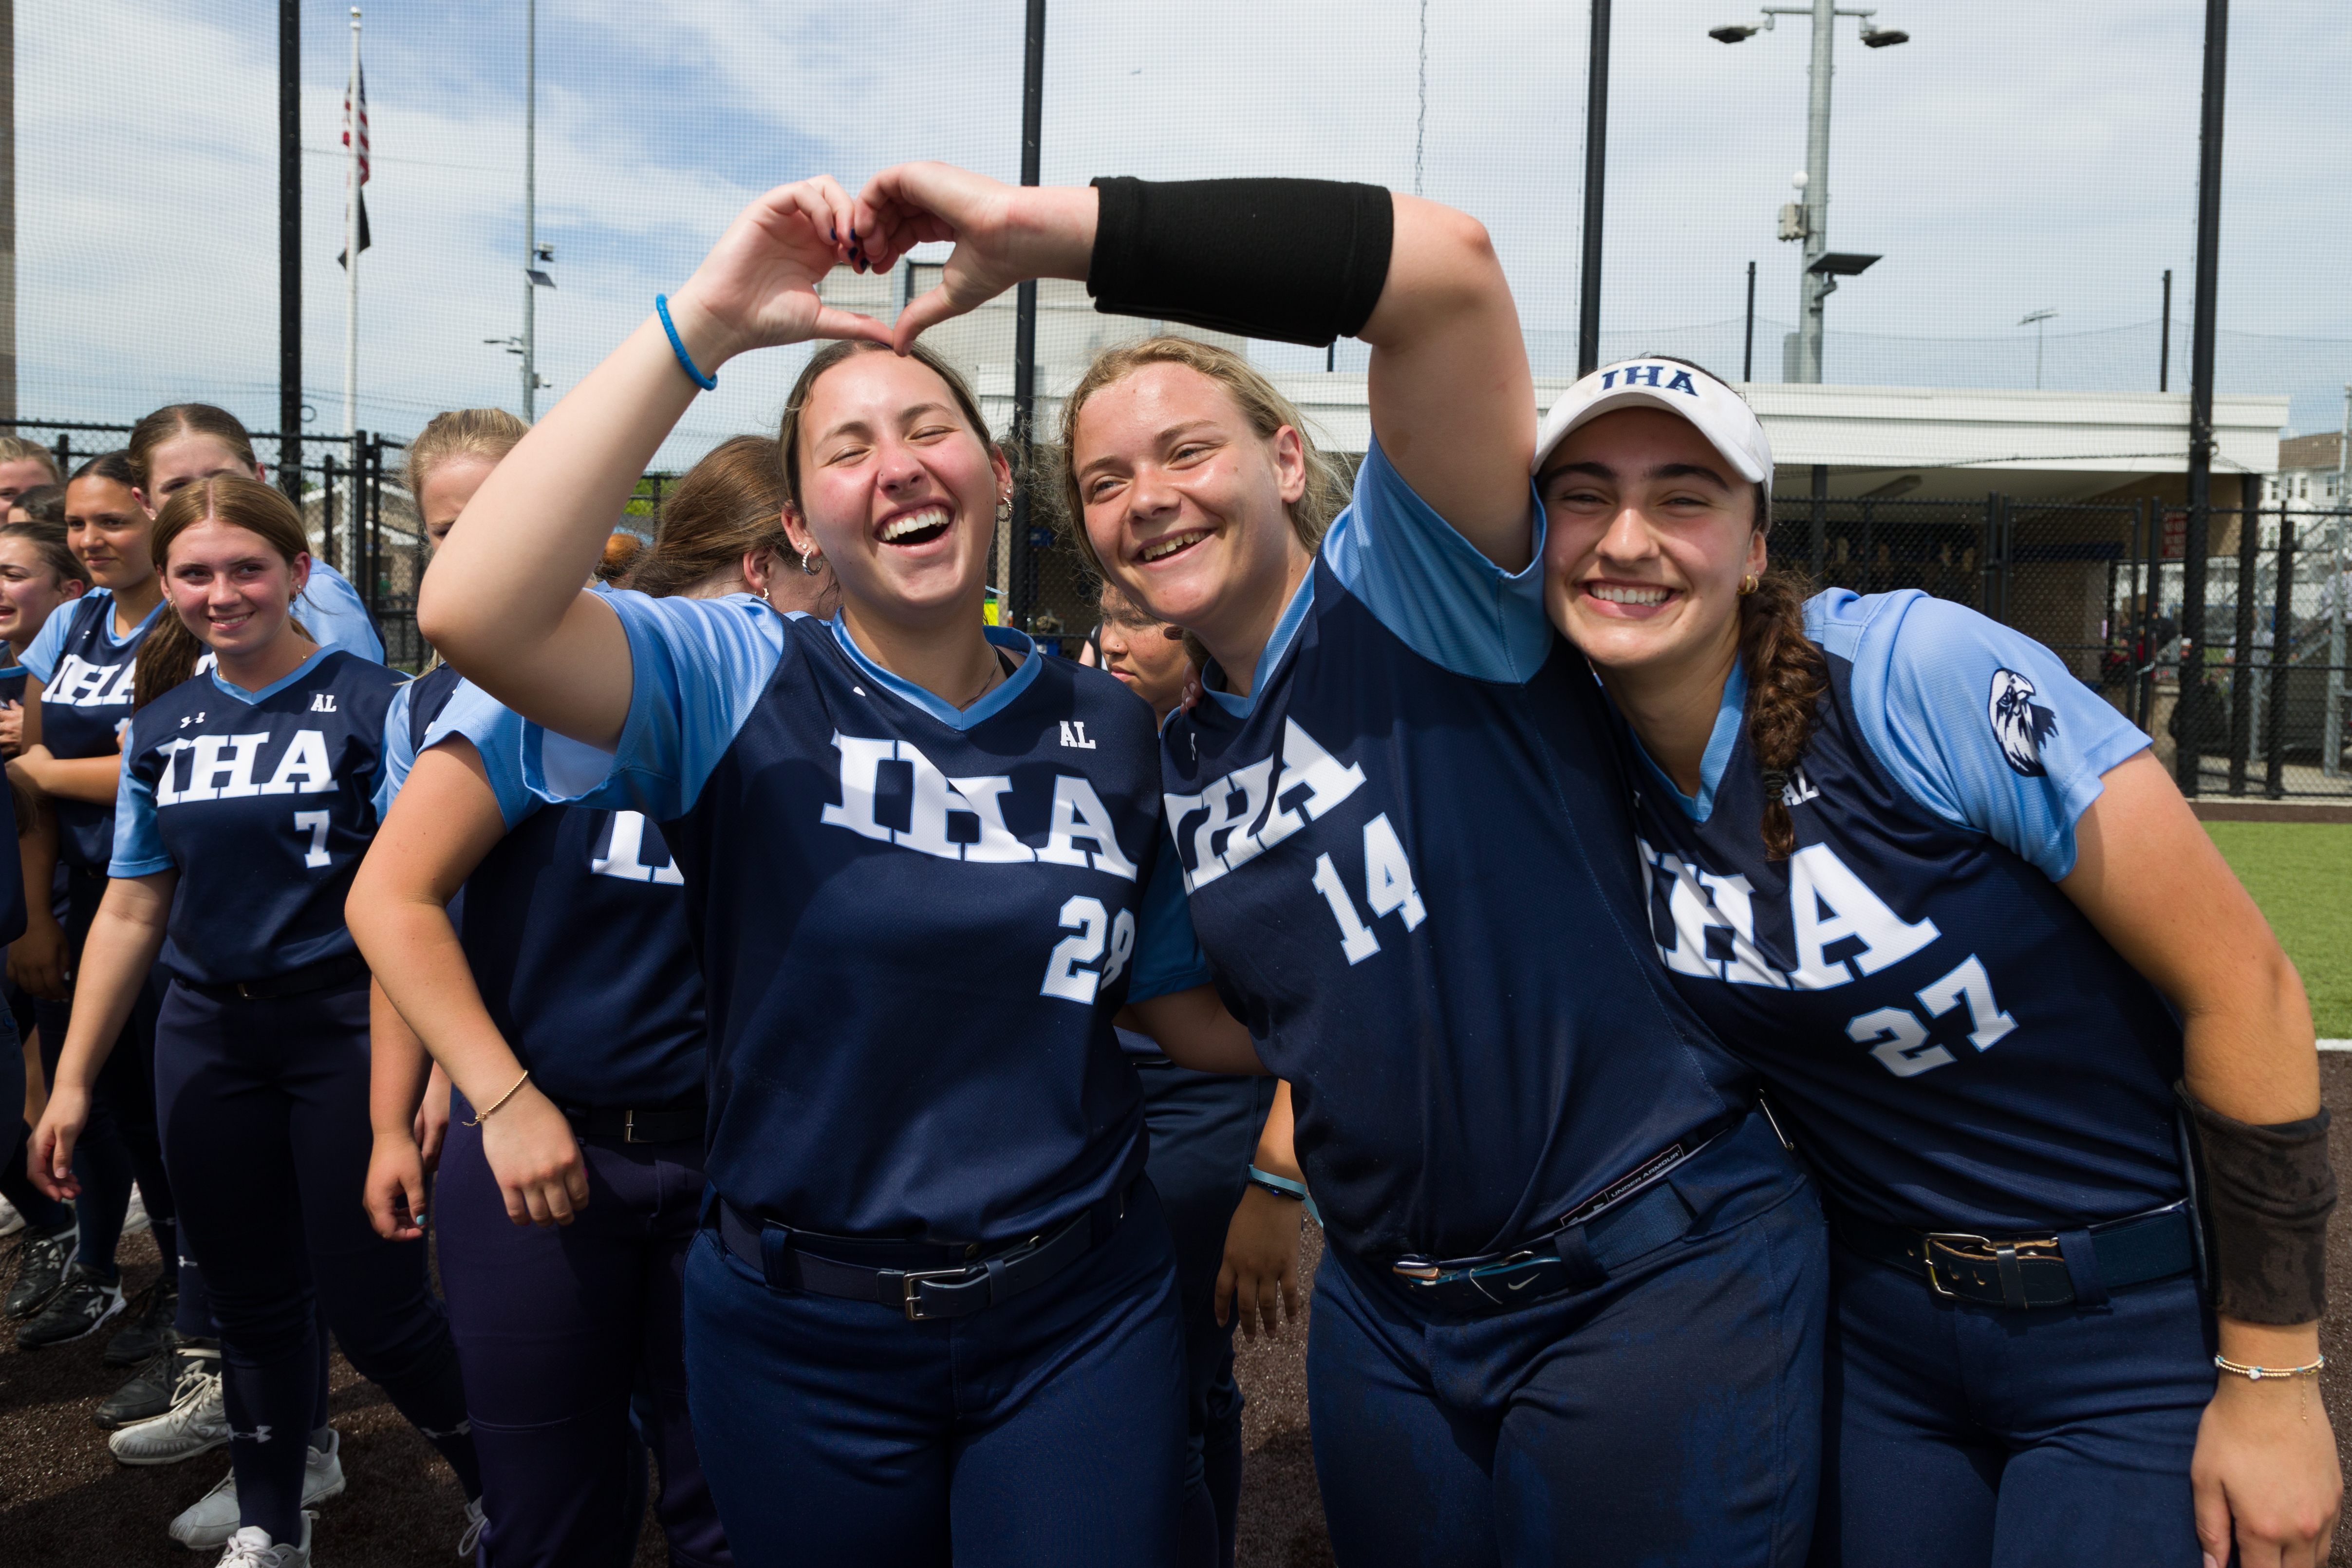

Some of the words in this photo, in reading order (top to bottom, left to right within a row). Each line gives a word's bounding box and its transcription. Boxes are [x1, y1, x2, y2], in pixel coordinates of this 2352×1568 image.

[1600, 365, 1699, 397] IHA
[310, 693, 337, 712] AL
[1059, 721, 1097, 749] AL
[155, 729, 339, 808] IHA
[1781, 765, 1820, 807] AL
[821, 728, 1138, 883] IHA
[294, 810, 332, 869] 7
[1311, 812, 1427, 966] 14
[1845, 952, 2019, 1078] 27
[1610, 1176, 1642, 1198] UNDER
[1643, 1151, 1680, 1179] ARMOUR
